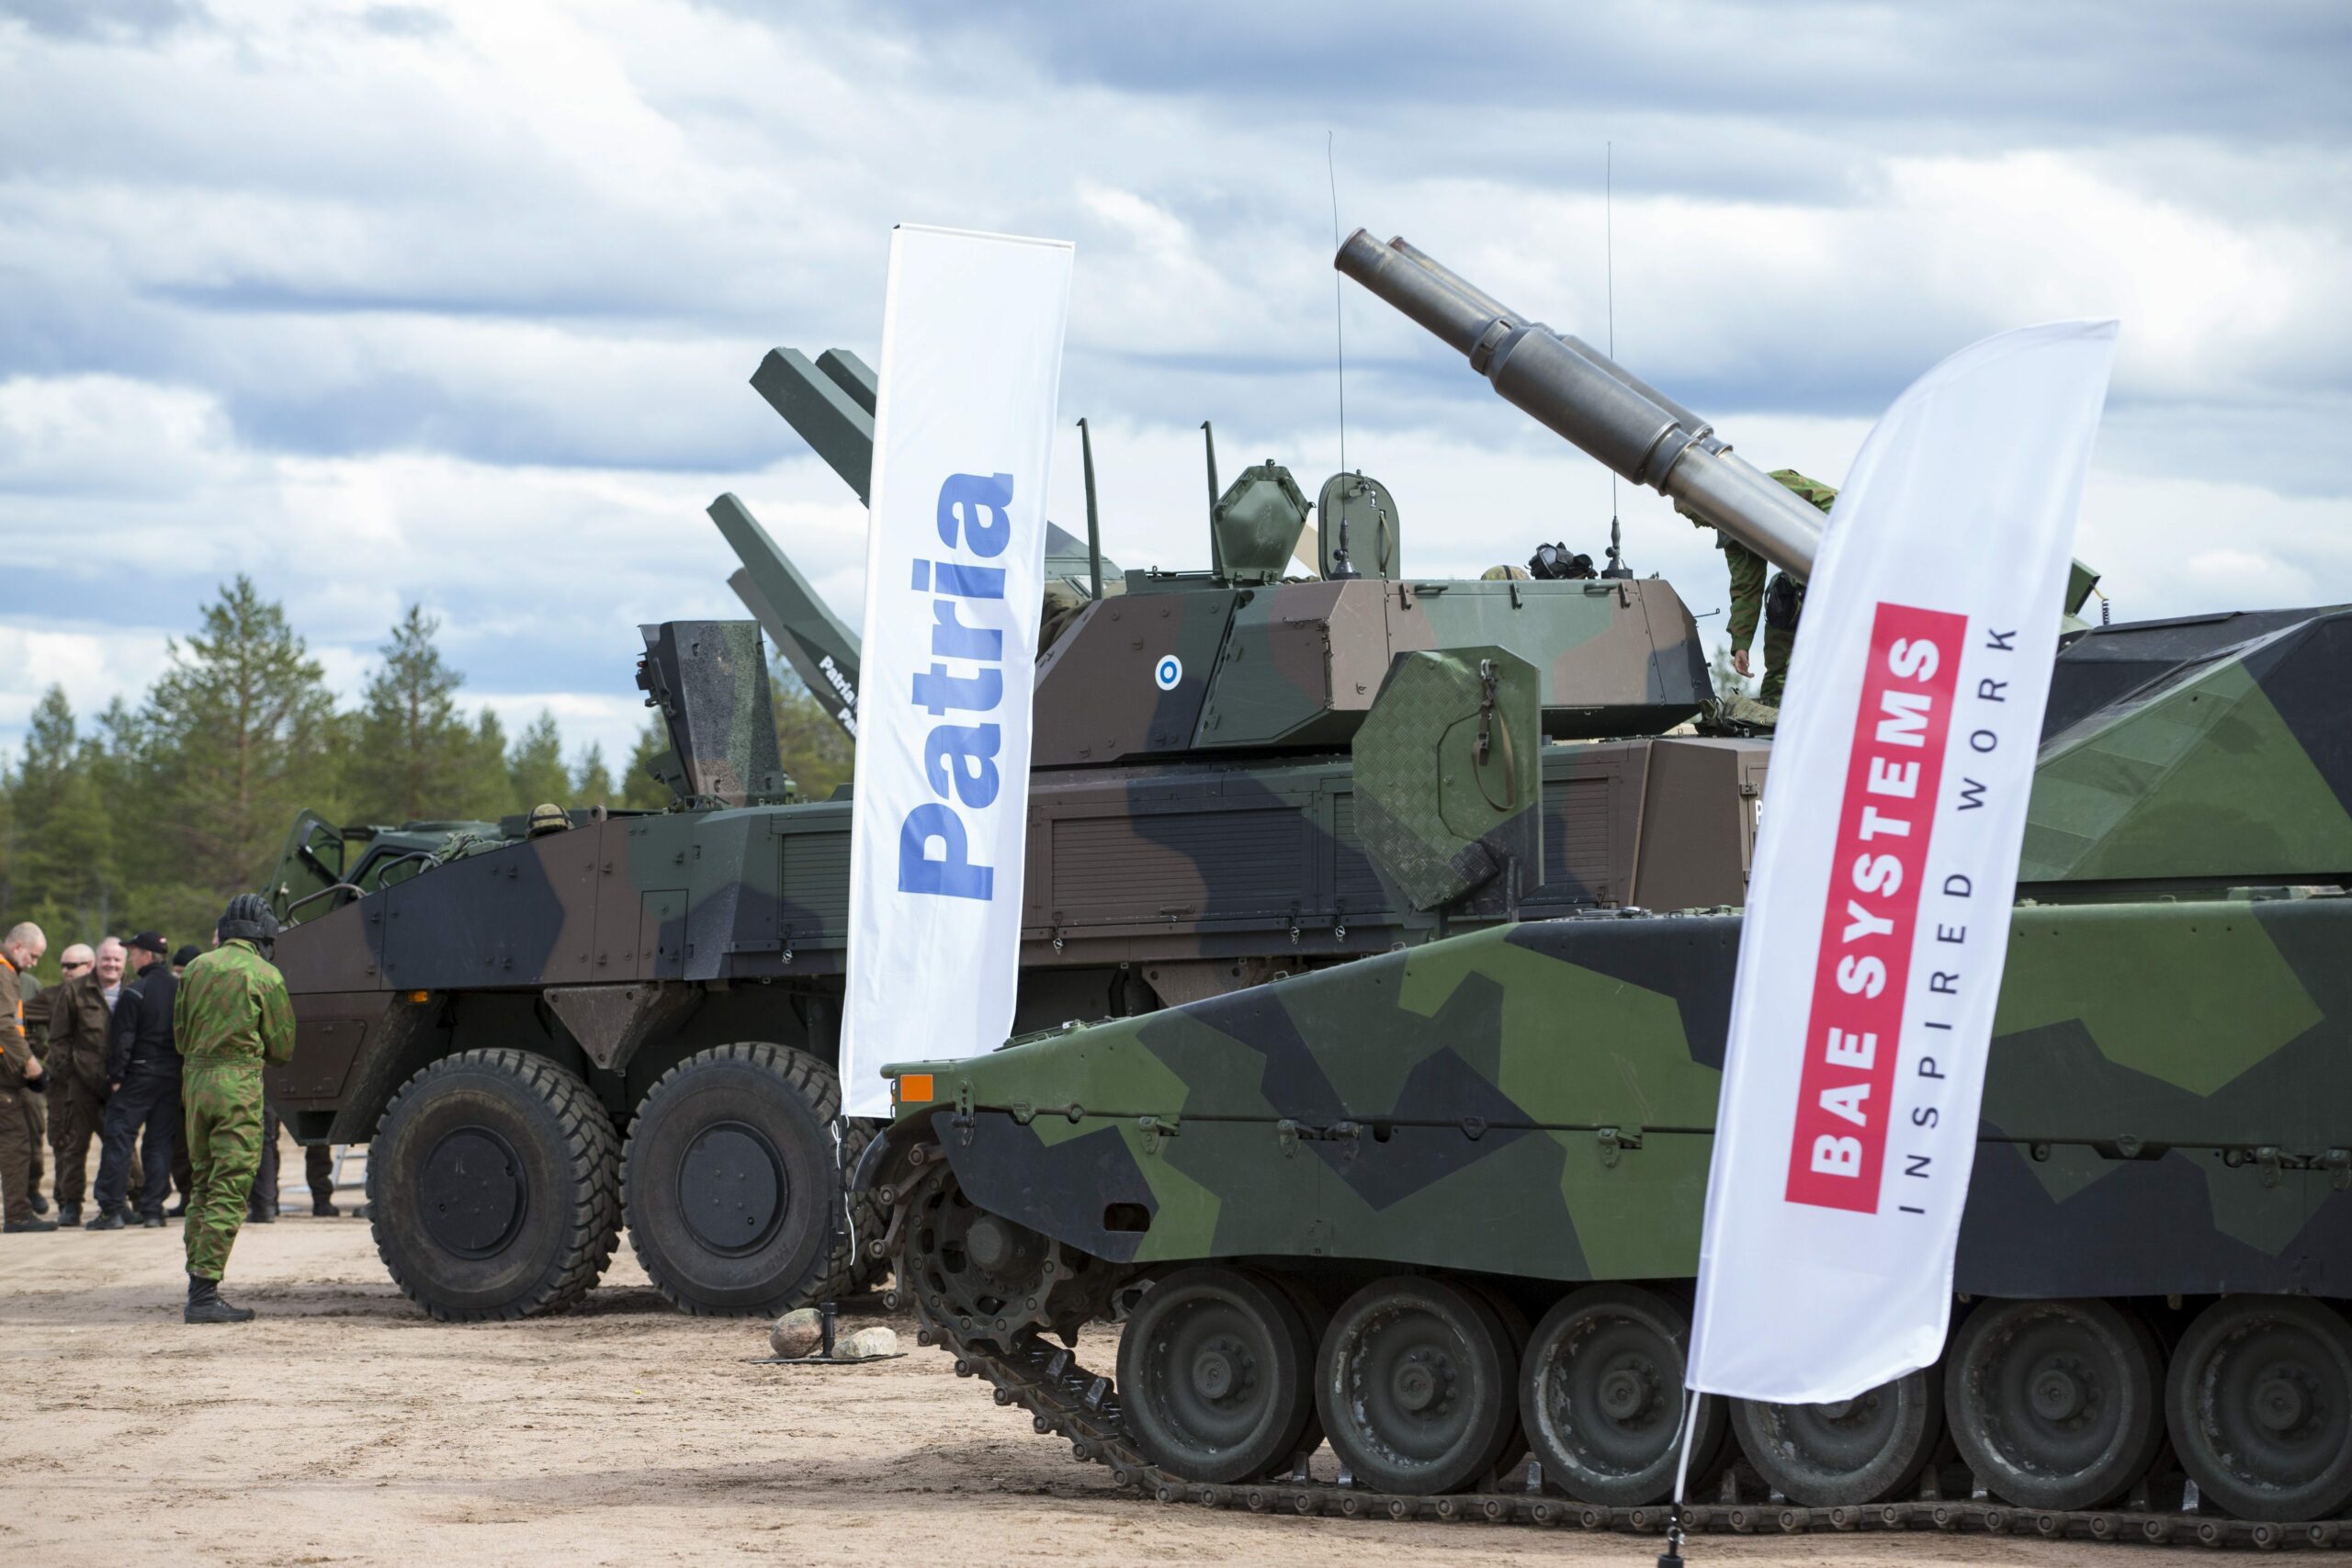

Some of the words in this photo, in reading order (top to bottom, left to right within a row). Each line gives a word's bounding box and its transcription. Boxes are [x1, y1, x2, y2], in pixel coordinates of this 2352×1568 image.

[898, 472, 1014, 901] Patria
[1837, 636, 1939, 1000] SYSTEMS
[1810, 1026, 1879, 1179] BAE
[1897, 873, 1973, 1215] INSPIRED
[1956, 627, 2018, 812] WORK
